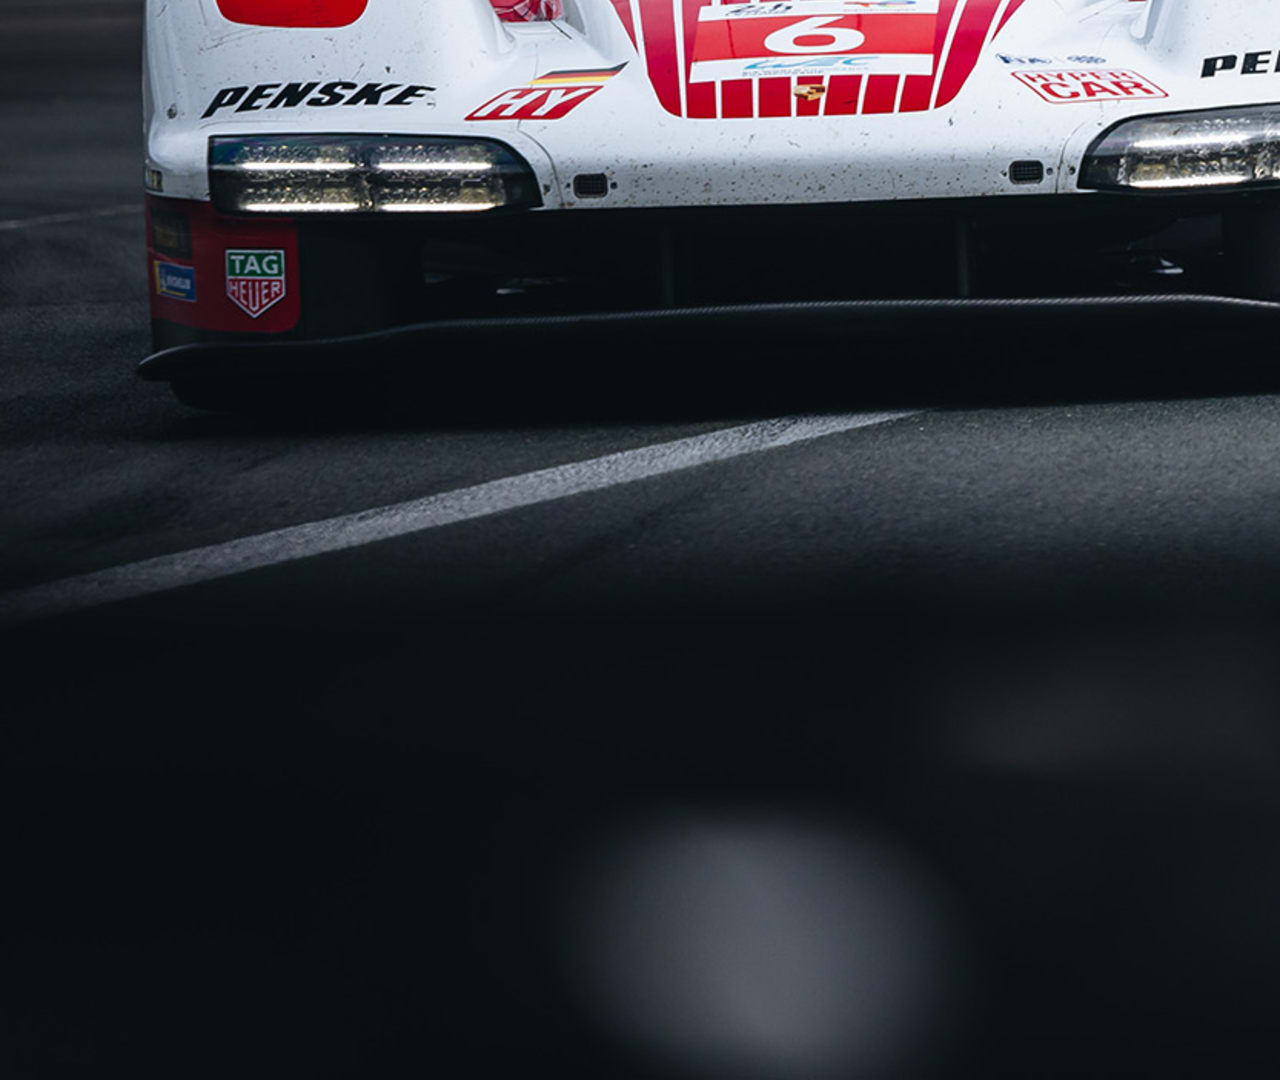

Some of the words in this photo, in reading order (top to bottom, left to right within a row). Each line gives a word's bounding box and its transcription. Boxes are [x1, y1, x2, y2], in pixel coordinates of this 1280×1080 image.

[764, 15, 865, 53] 6
[1022, 71, 1134, 83] HYPER
[1040, 80, 1155, 99] CAR
[201, 81, 437, 118] PENSKE
[474, 88, 589, 117] HY
[230, 255, 279, 274] TAG
[229, 281, 281, 312] HEUER
